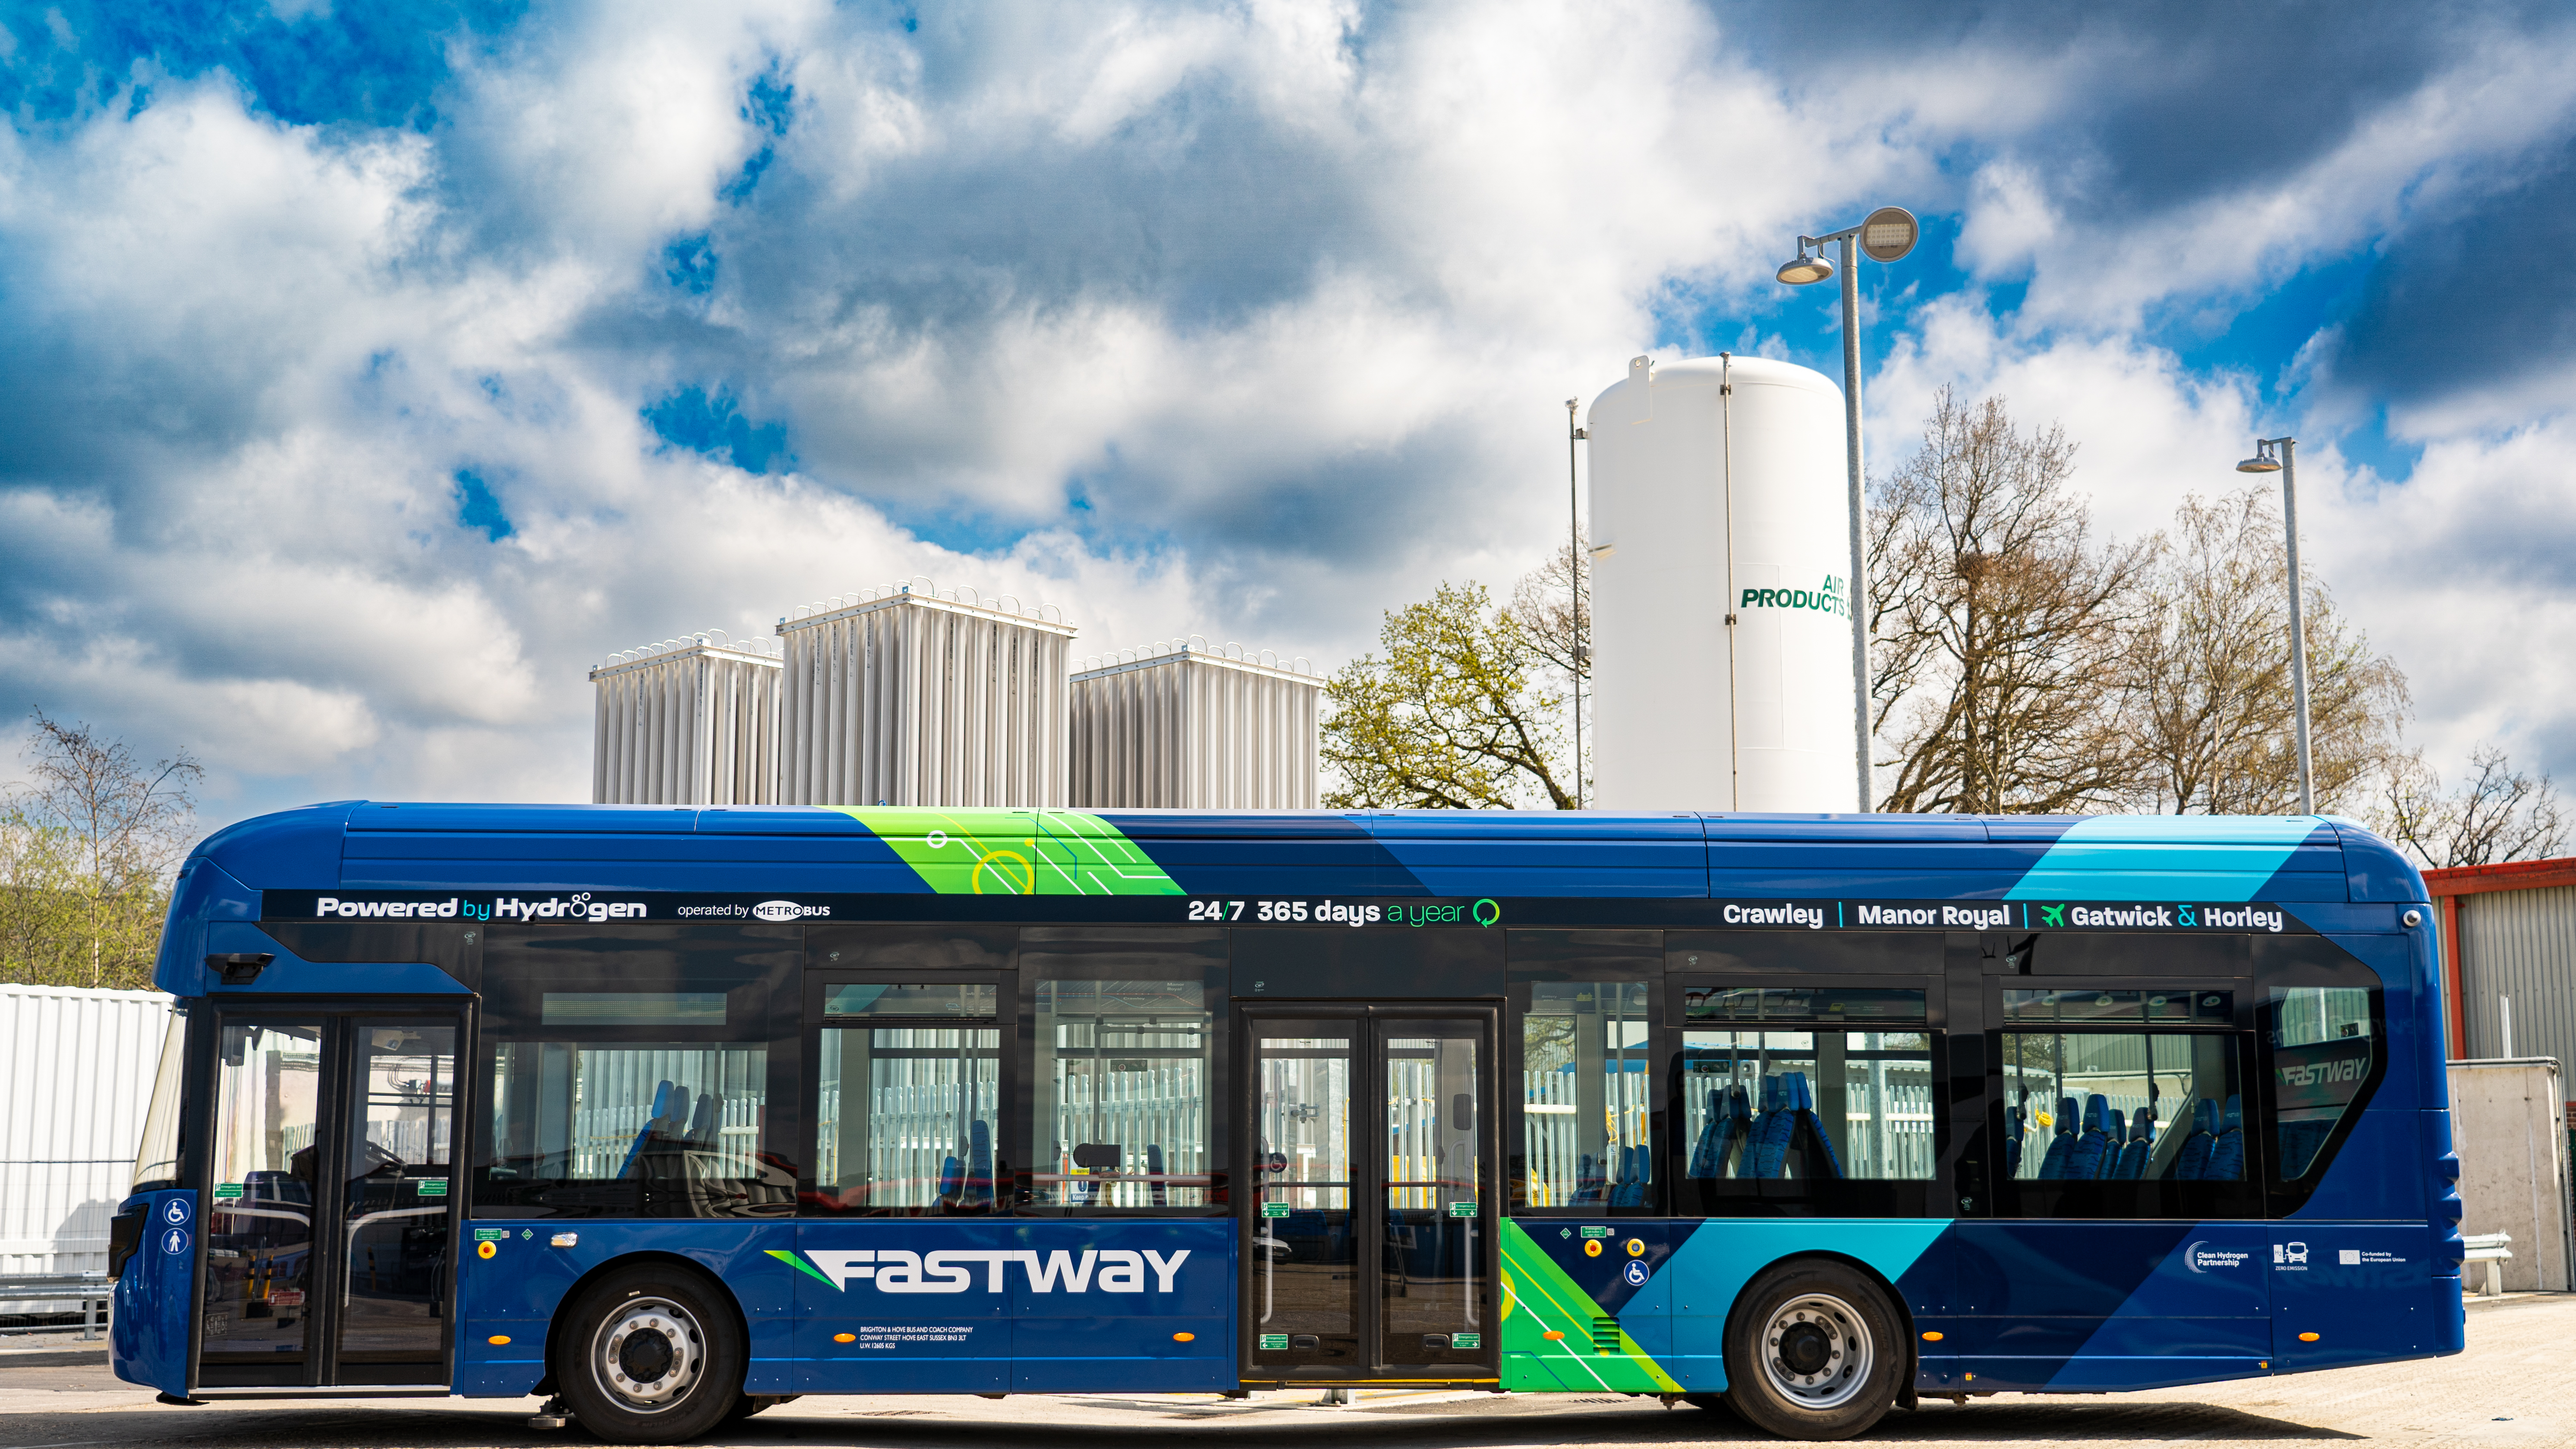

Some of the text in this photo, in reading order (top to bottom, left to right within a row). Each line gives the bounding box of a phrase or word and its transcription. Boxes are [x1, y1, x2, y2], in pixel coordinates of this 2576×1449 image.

[1822, 574, 1844, 597] AIR
[1741, 588, 1845, 616] PRODUCTS
[317, 892, 647, 922] Powered by Hydrogen
[678, 904, 731, 918] operated
[735, 904, 749, 918] by
[1188, 900, 1465, 927] 24/7 365 days a year
[1723, 903, 1823, 929] Crawley
[1858, 905, 2010, 930] Manor Royal
[2071, 904, 2283, 932] Gatwick & Horley
[2198, 1259, 2239, 1267] Partnership
[2217, 1252, 2248, 1260] Hydrogen
